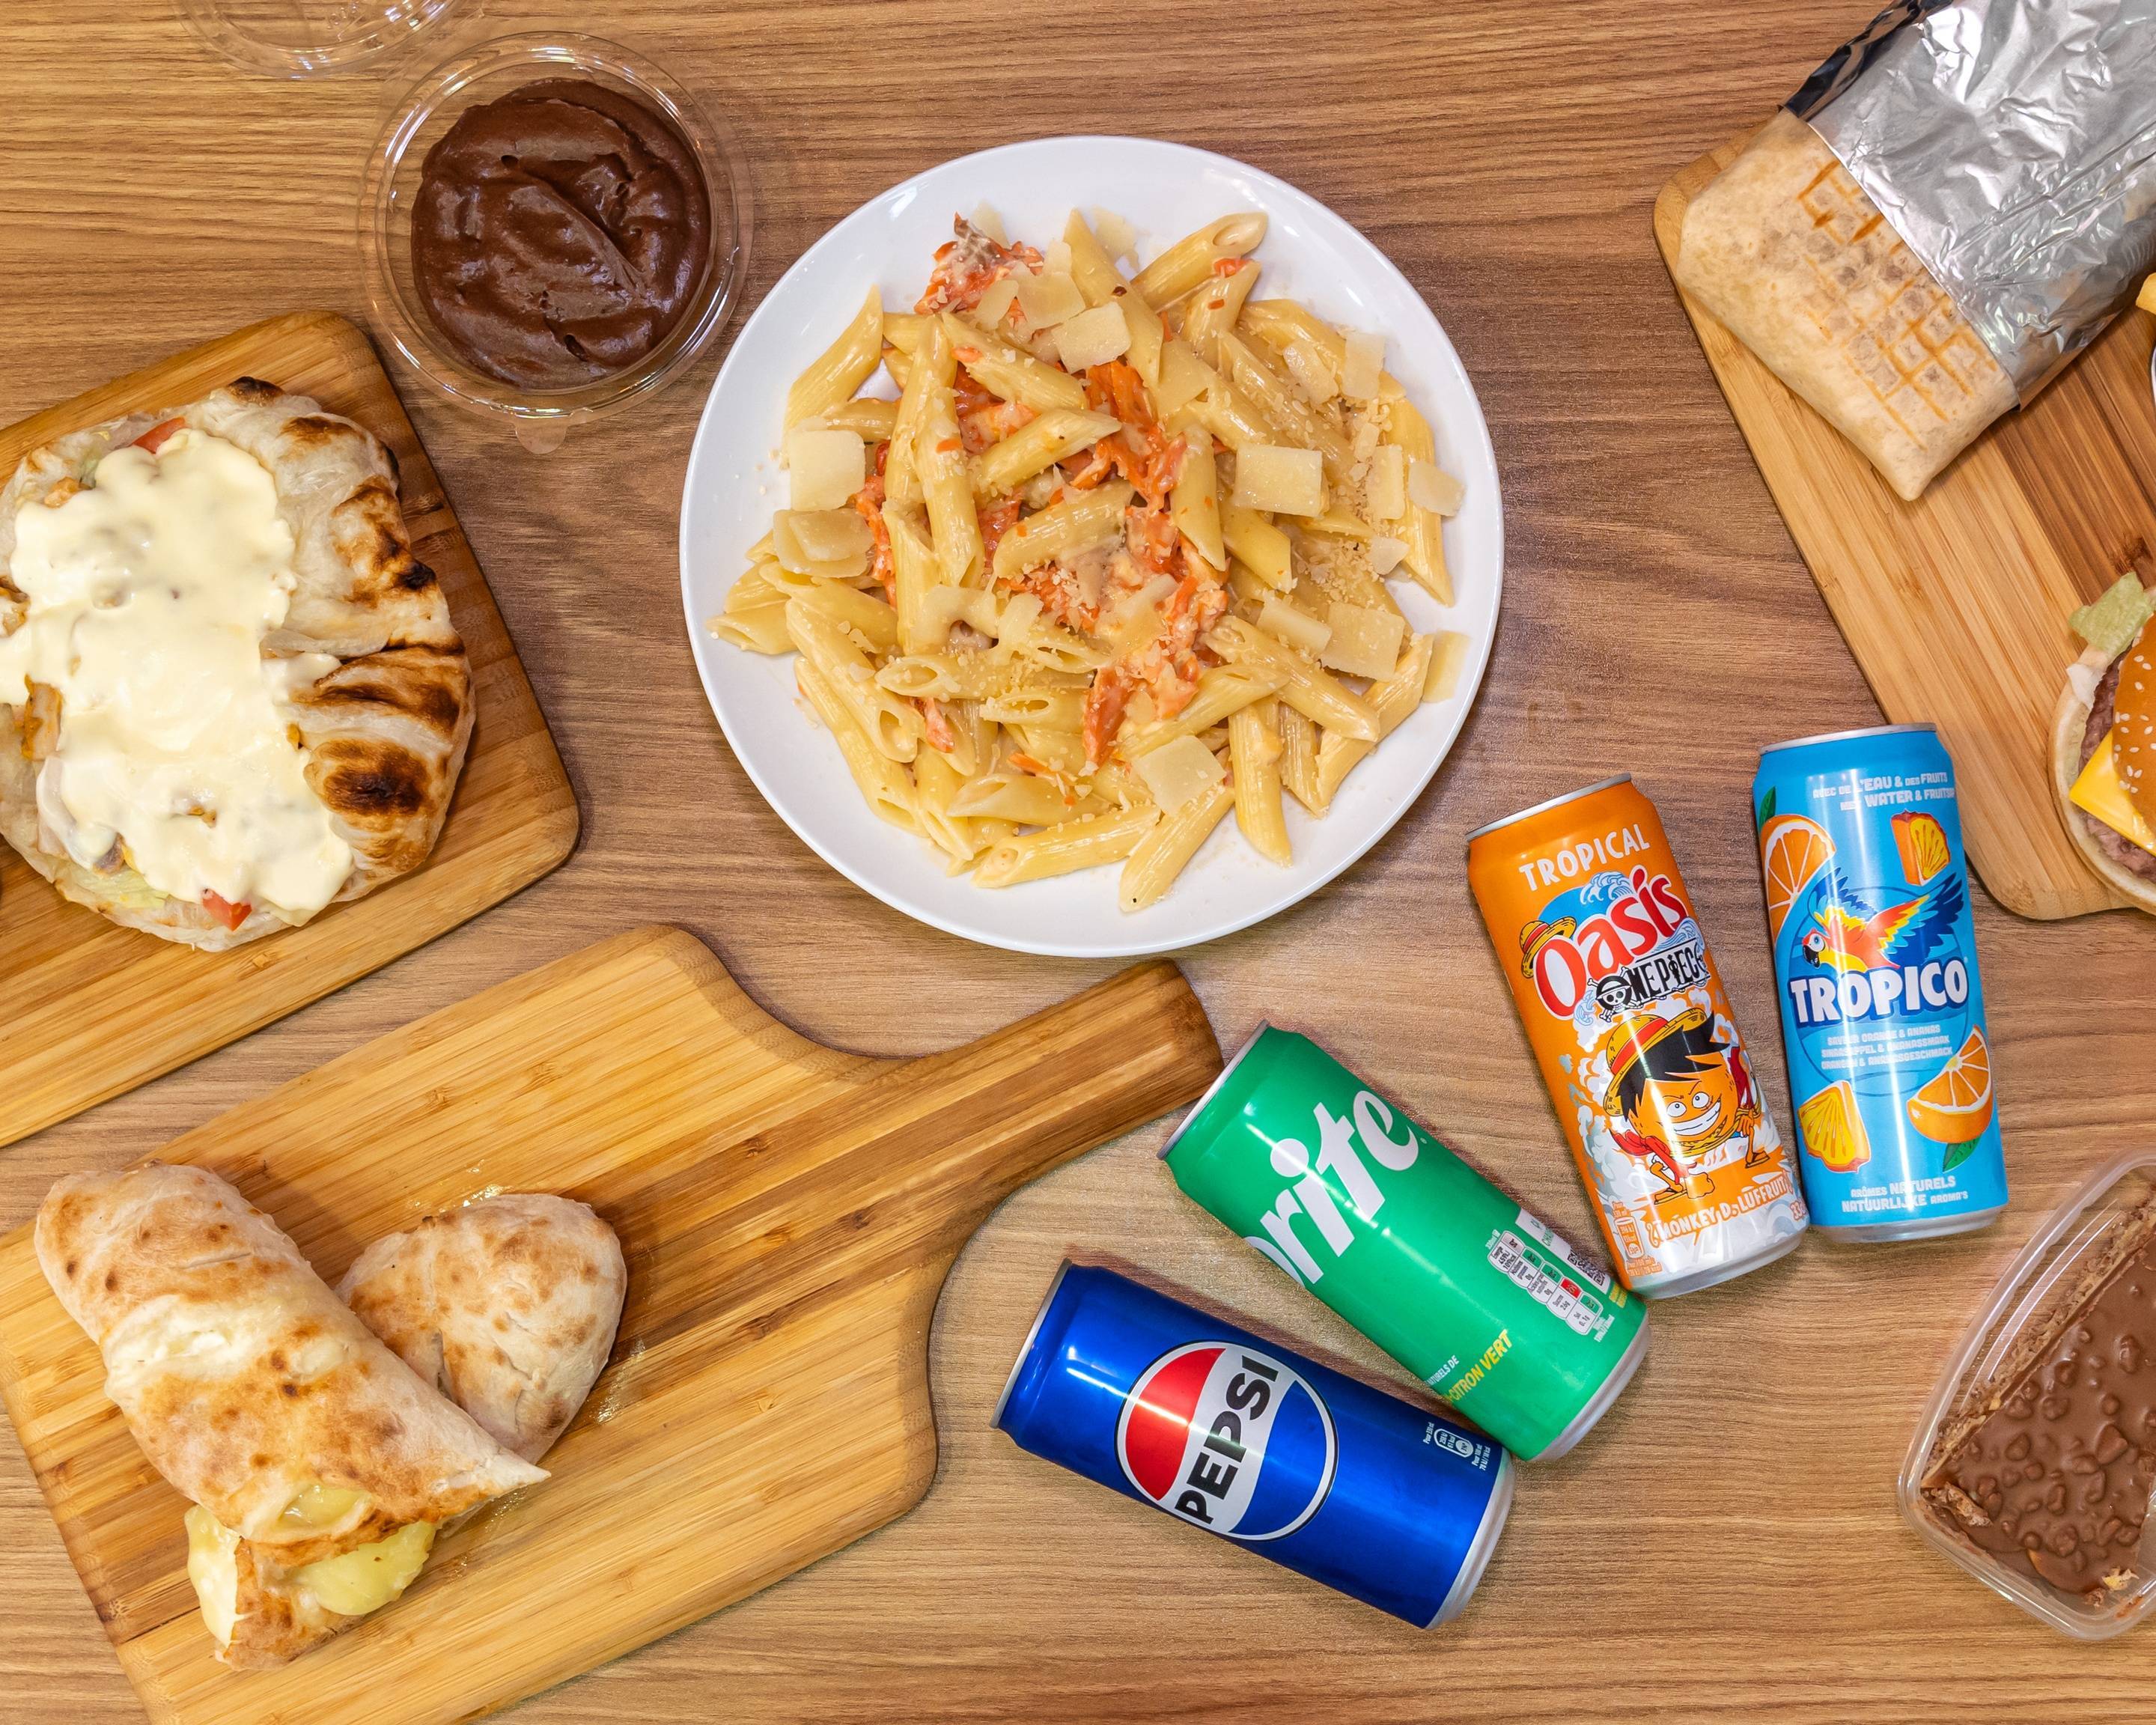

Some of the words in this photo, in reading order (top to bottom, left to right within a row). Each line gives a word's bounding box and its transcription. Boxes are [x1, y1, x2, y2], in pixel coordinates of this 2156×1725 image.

[1894, 776, 1903, 788] &
[1904, 776, 1920, 786] DES
[1921, 772, 1947, 784] FRUITS
[1864, 790, 1915, 807] WATER
[1915, 790, 1922, 801] &
[1519, 824, 1650, 892] TROPICAL
[1790, 960, 1968, 1023] TROPICO
[1889, 1175, 1956, 1195] NATURELS
[1448, 1355, 1459, 1369] DE
[1479, 1328, 1512, 1371] VERT
[1174, 1354, 1279, 1524] PEPSI
